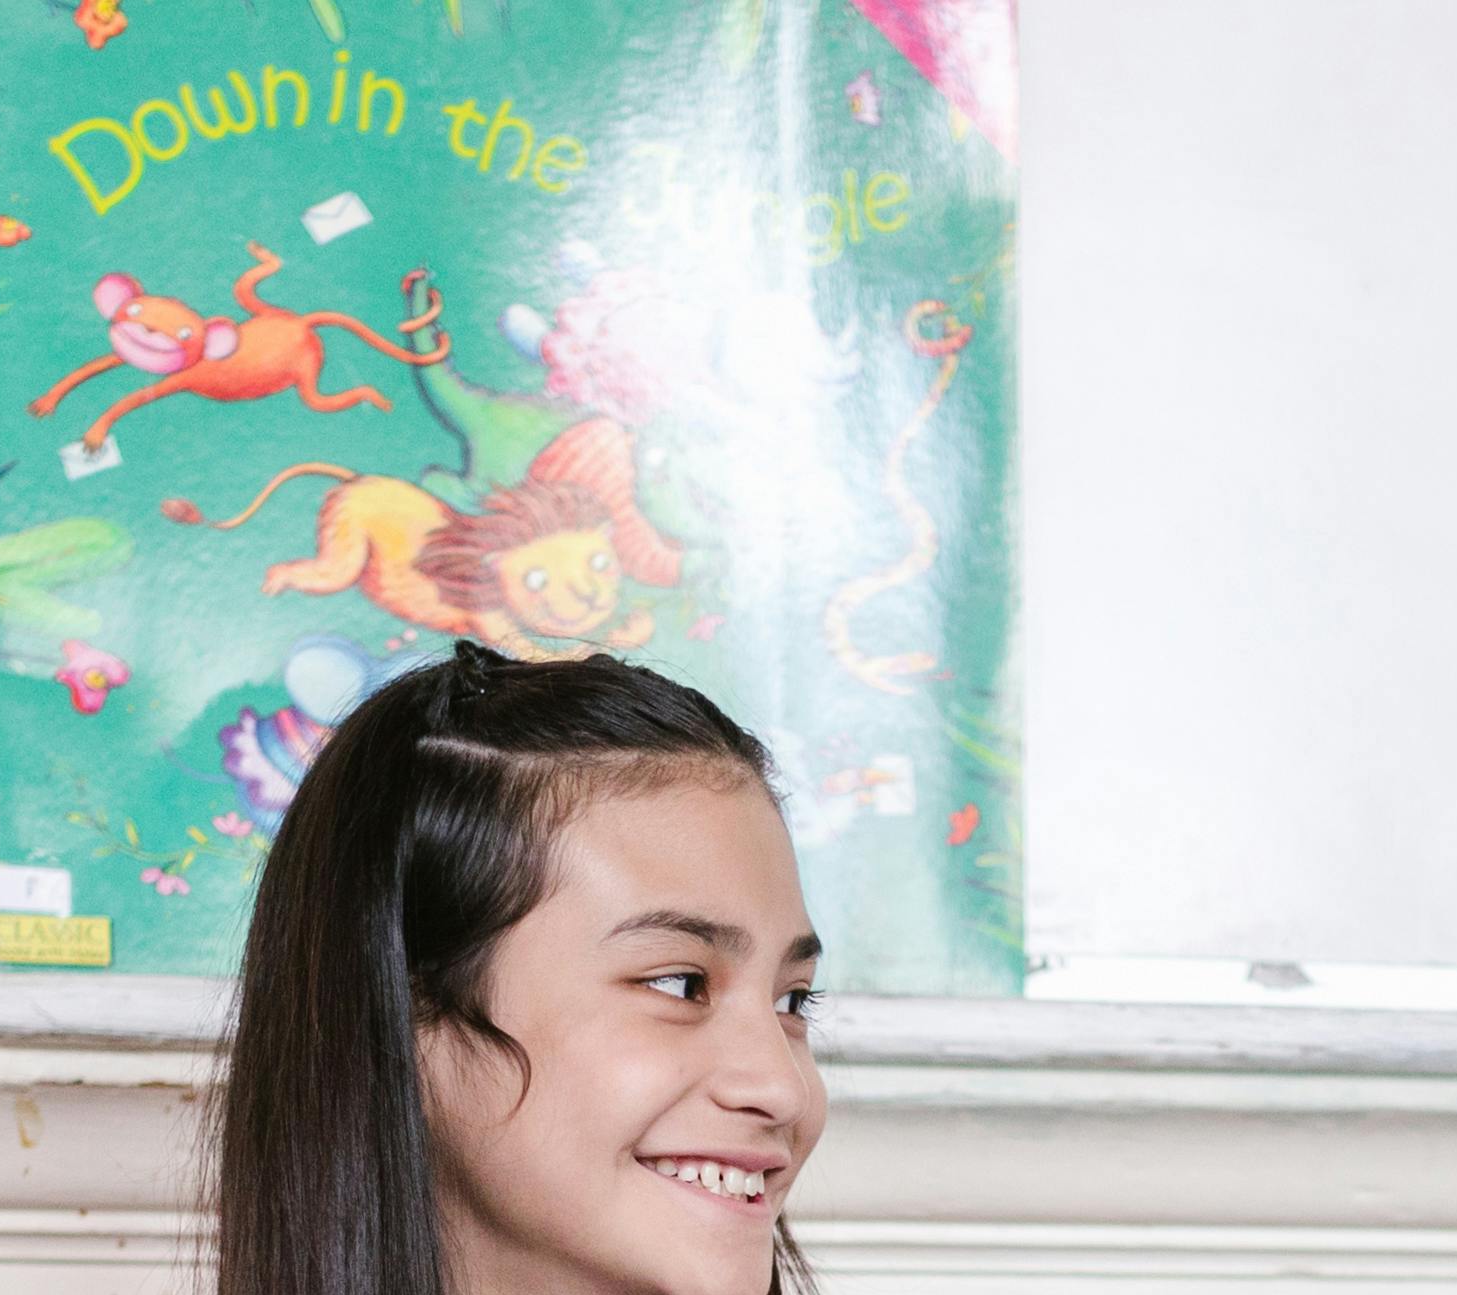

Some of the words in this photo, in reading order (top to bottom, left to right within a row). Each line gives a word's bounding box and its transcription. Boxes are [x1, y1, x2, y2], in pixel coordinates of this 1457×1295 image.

[48, 64, 311, 216] Down
[328, 48, 406, 136] in
[442, 98, 589, 193] the
[623, 139, 911, 268] Jngle
